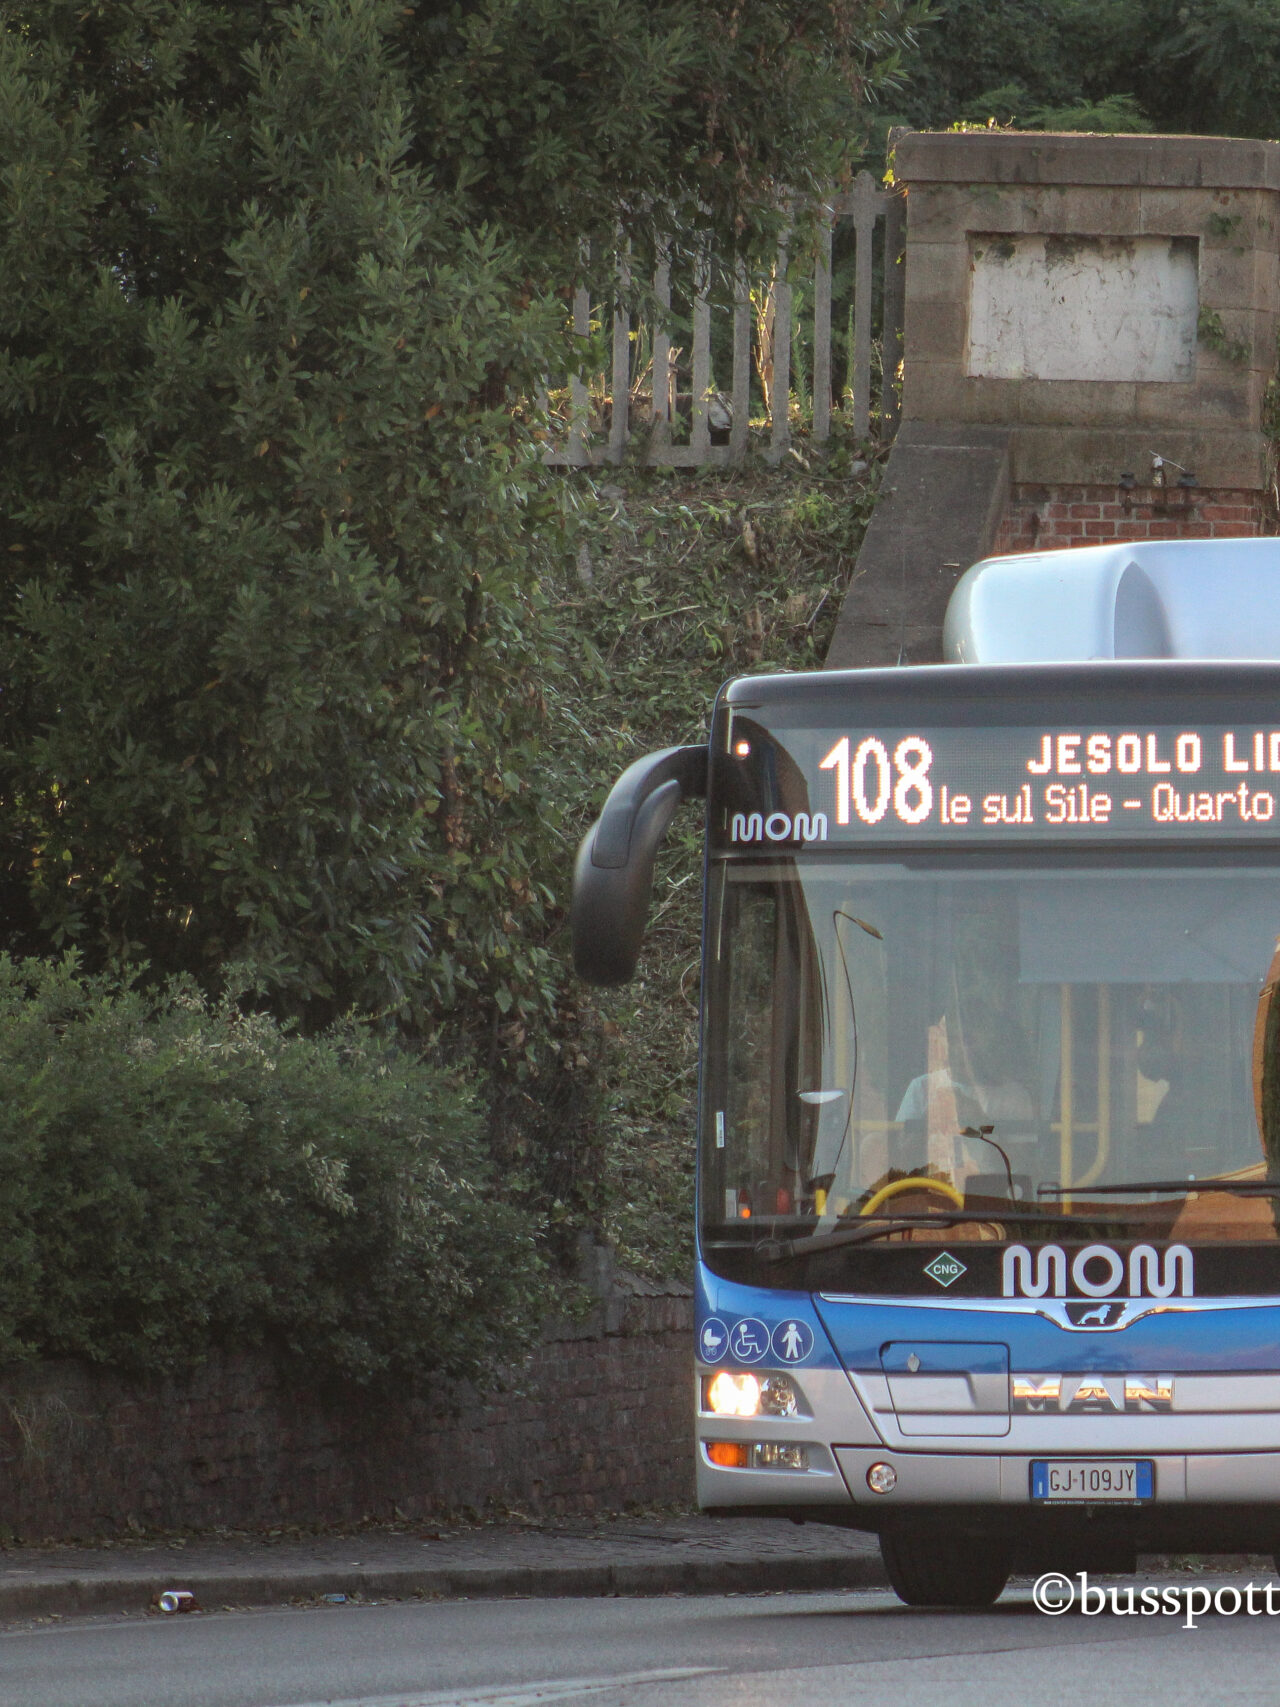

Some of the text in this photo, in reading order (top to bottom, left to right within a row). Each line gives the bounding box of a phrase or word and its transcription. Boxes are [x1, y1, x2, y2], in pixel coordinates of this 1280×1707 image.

[1027, 733, 1202, 775] JESOLO
[819, 736, 933, 825] 108
[940, 785, 972, 824] le
[982, 784, 1034, 824] sul
[1044, 784, 1112, 823] Sile
[1151, 782, 1275, 822] Quarto
[732, 813, 828, 842] MOM
[933, 1263, 958, 1276] CNG
[1003, 1244, 1194, 1298] MOM
[1012, 1374, 1174, 1412] MAN
